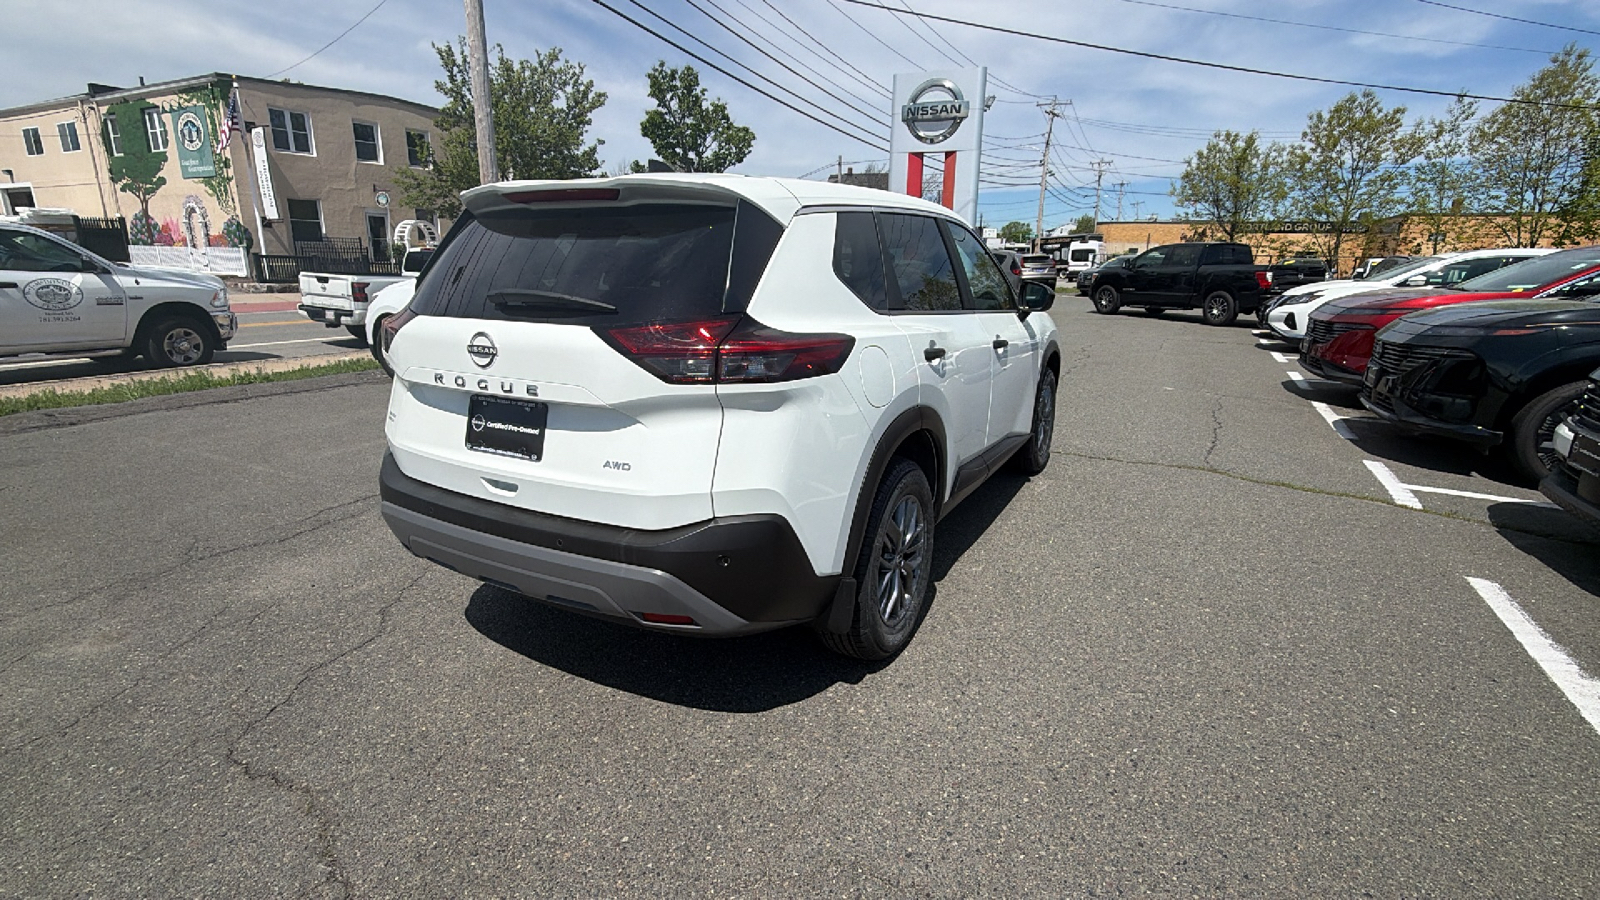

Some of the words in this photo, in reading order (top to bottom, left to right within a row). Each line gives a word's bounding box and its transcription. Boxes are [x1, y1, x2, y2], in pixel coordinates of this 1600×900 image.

[907, 104, 962, 117] NISSAN
[467, 345, 497, 354] NISSAN
[434, 372, 539, 397] ROGUE
[486, 421, 508, 431] Certified
[508, 424, 540, 435] Pre-Owned
[602, 460, 632, 471] AWD
